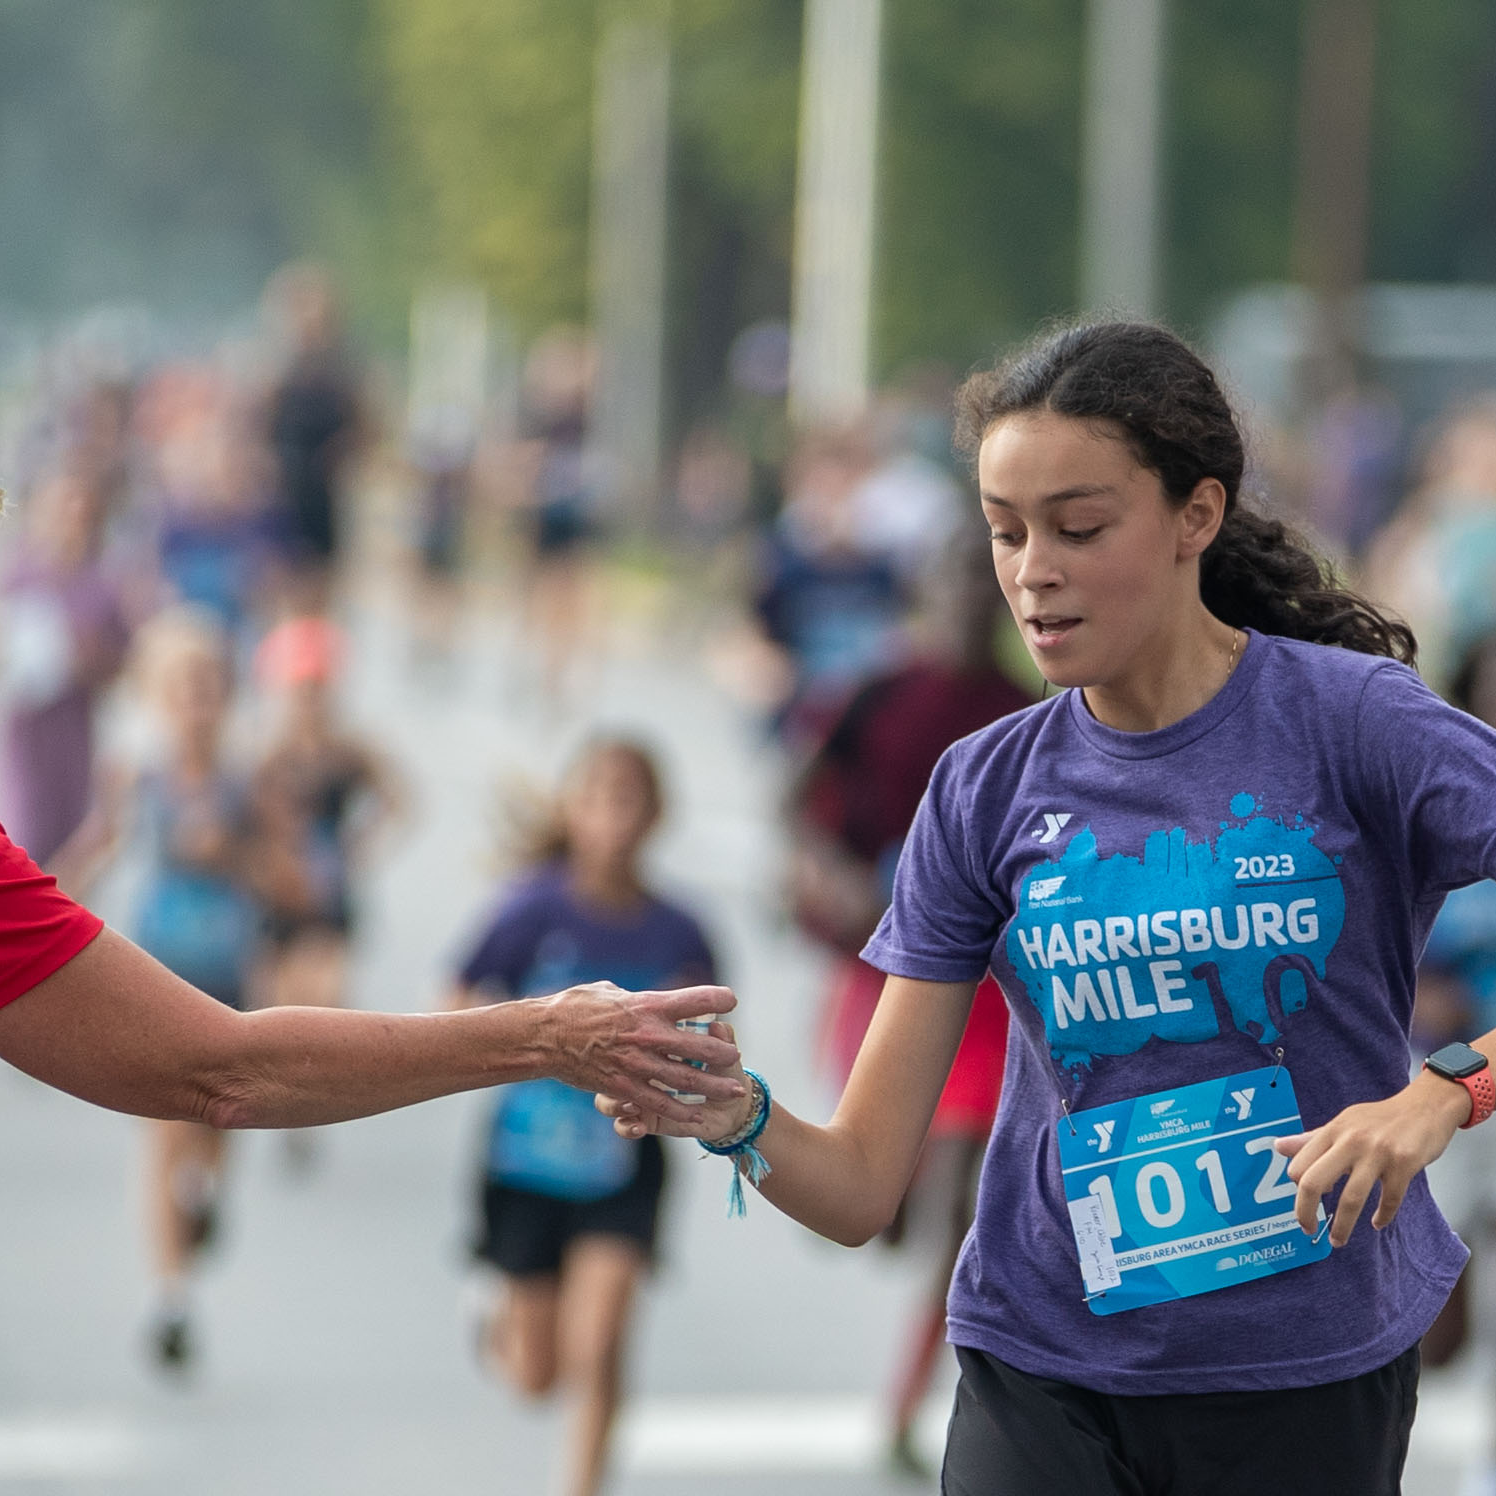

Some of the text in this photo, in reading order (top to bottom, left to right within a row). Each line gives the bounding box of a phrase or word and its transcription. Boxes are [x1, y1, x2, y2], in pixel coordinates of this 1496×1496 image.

[1234, 854, 1296, 880] 2023
[1017, 898, 1319, 969] HARRISBURG
[1051, 960, 1194, 1030] MILE
[1136, 1120, 1211, 1144] HARRISBURG MILE
[1159, 1117, 1184, 1130] YMCA
[1088, 1136, 1299, 1239] 1012
[1153, 1247, 1178, 1259] AREA
[1177, 1241, 1206, 1254] YMCA
[1206, 1234, 1232, 1246] RACE
[1232, 1224, 1266, 1240] SERIES
[1238, 1241, 1296, 1266] DONEGAL
